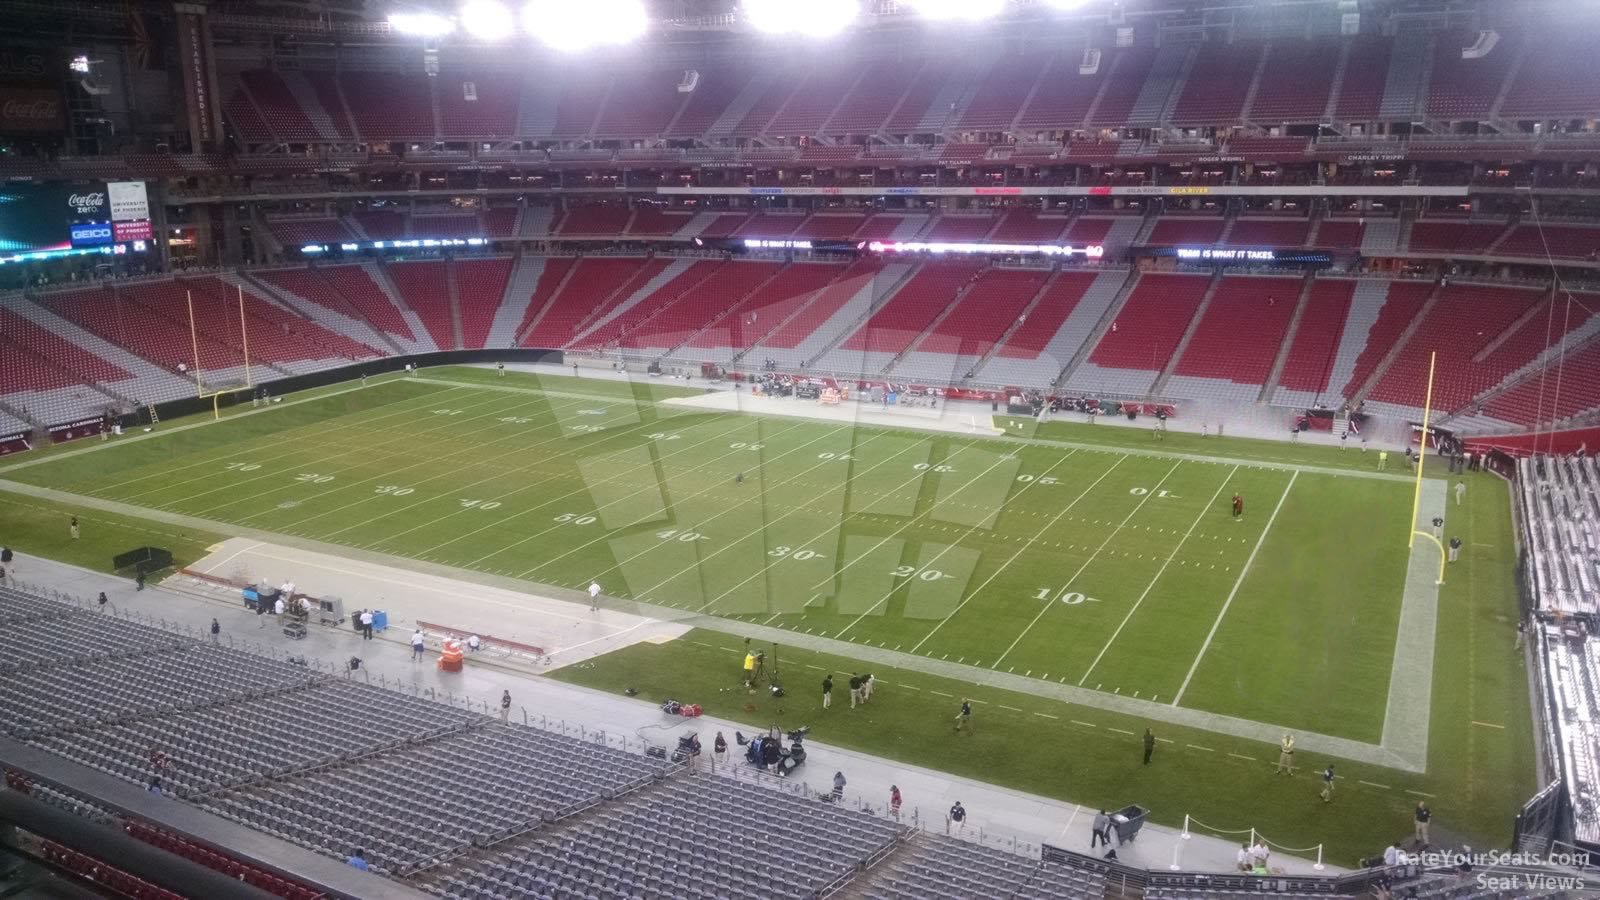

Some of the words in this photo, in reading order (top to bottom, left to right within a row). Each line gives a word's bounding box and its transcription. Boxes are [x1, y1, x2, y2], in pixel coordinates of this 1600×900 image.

[190, 27, 205, 109] ESTABLISHED
[68, 193, 104, 207] Coca-Cola
[72, 228, 111, 239] GEICO
[744, 239, 761, 248] TEAM
[769, 240, 785, 248] WHAT
[786, 240, 792, 248] IT
[1177, 249, 1200, 258] TEAM
[1203, 249, 1211, 258] IS
[1212, 250, 1236, 259] WHAT
[1238, 250, 1246, 259] IT
[1247, 250, 1275, 260] TAKES.
[72, 417, 104, 428] CARDINALS
[226, 462, 262, 471] 10
[913, 462, 951, 473] 30
[296, 473, 335, 483] 20
[1016, 474, 1058, 485] 20
[375, 485, 415, 496] 30
[1129, 487, 1169, 498] 10
[459, 498, 502, 510] 40
[553, 513, 597, 525] 50
[655, 529, 700, 542] 40
[767, 546, 816, 561] 30
[889, 565, 943, 581] 20
[1032, 587, 1085, 605] 10
